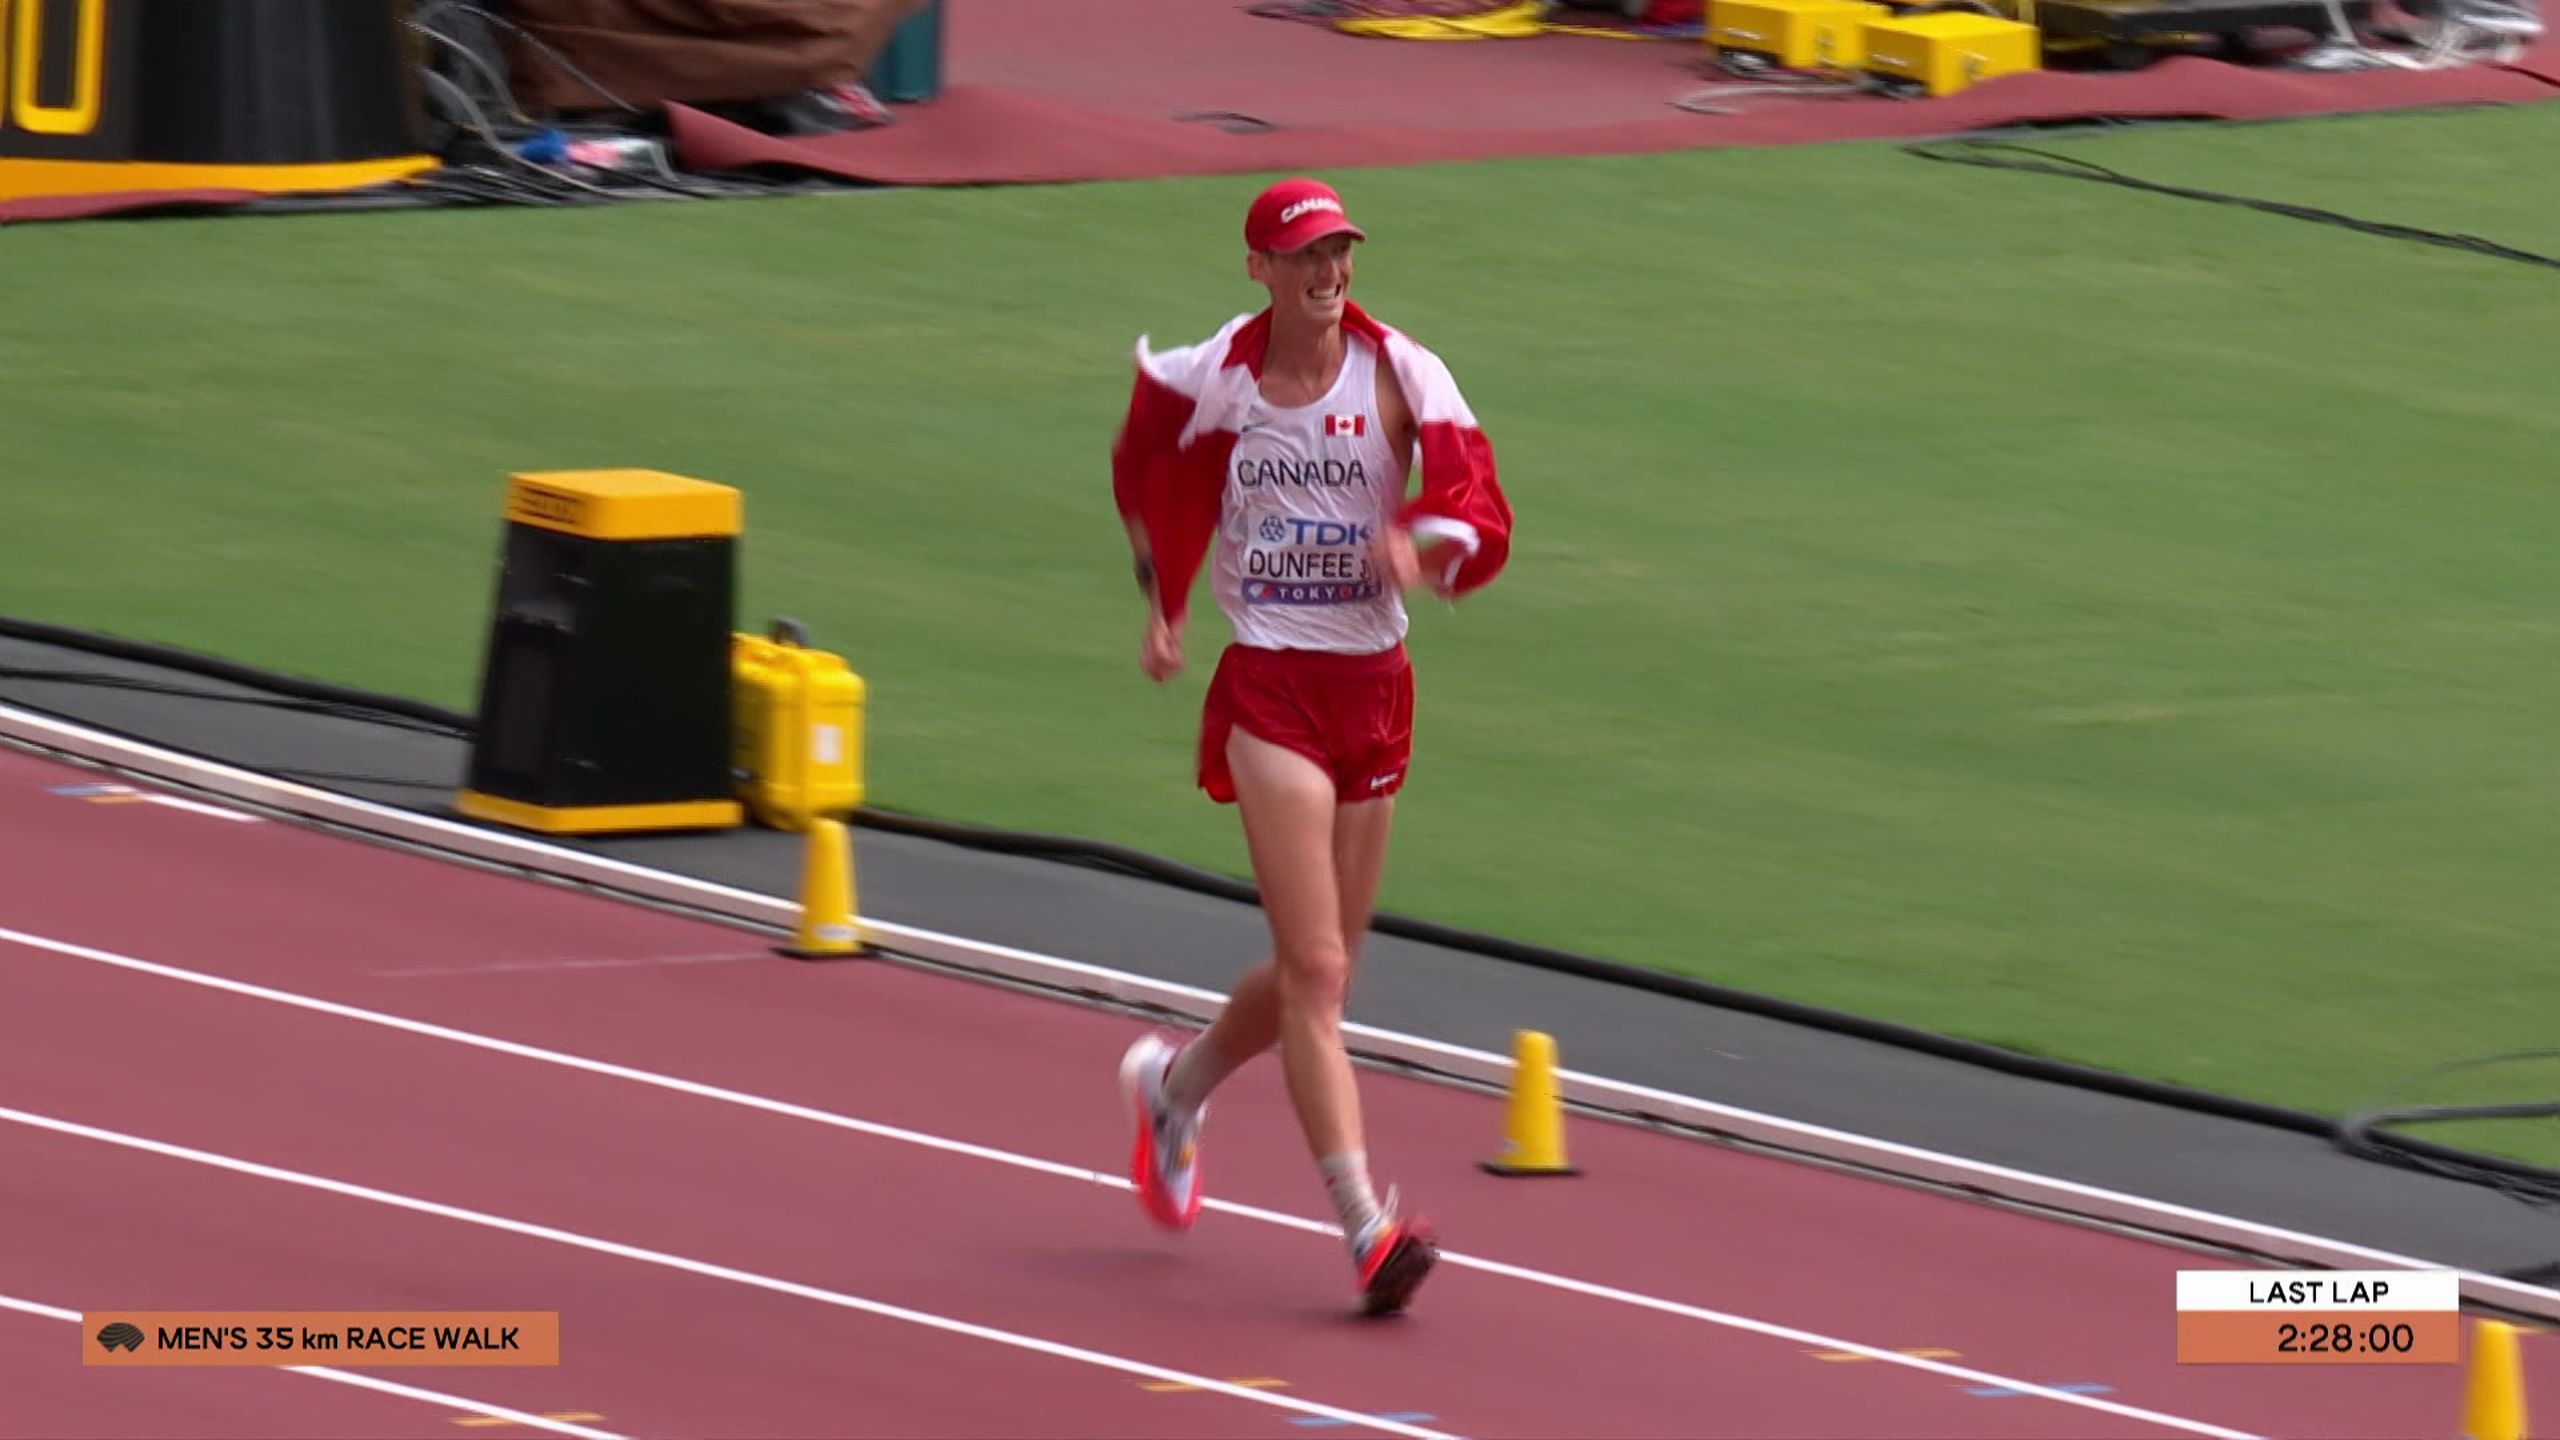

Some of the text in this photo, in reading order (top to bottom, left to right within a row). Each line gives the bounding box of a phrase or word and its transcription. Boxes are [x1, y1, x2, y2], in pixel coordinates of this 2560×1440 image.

[1237, 459, 1367, 488] CANADA
[1250, 549, 1353, 578] DUNFEE
[1278, 586, 1353, 599] TOKYO
